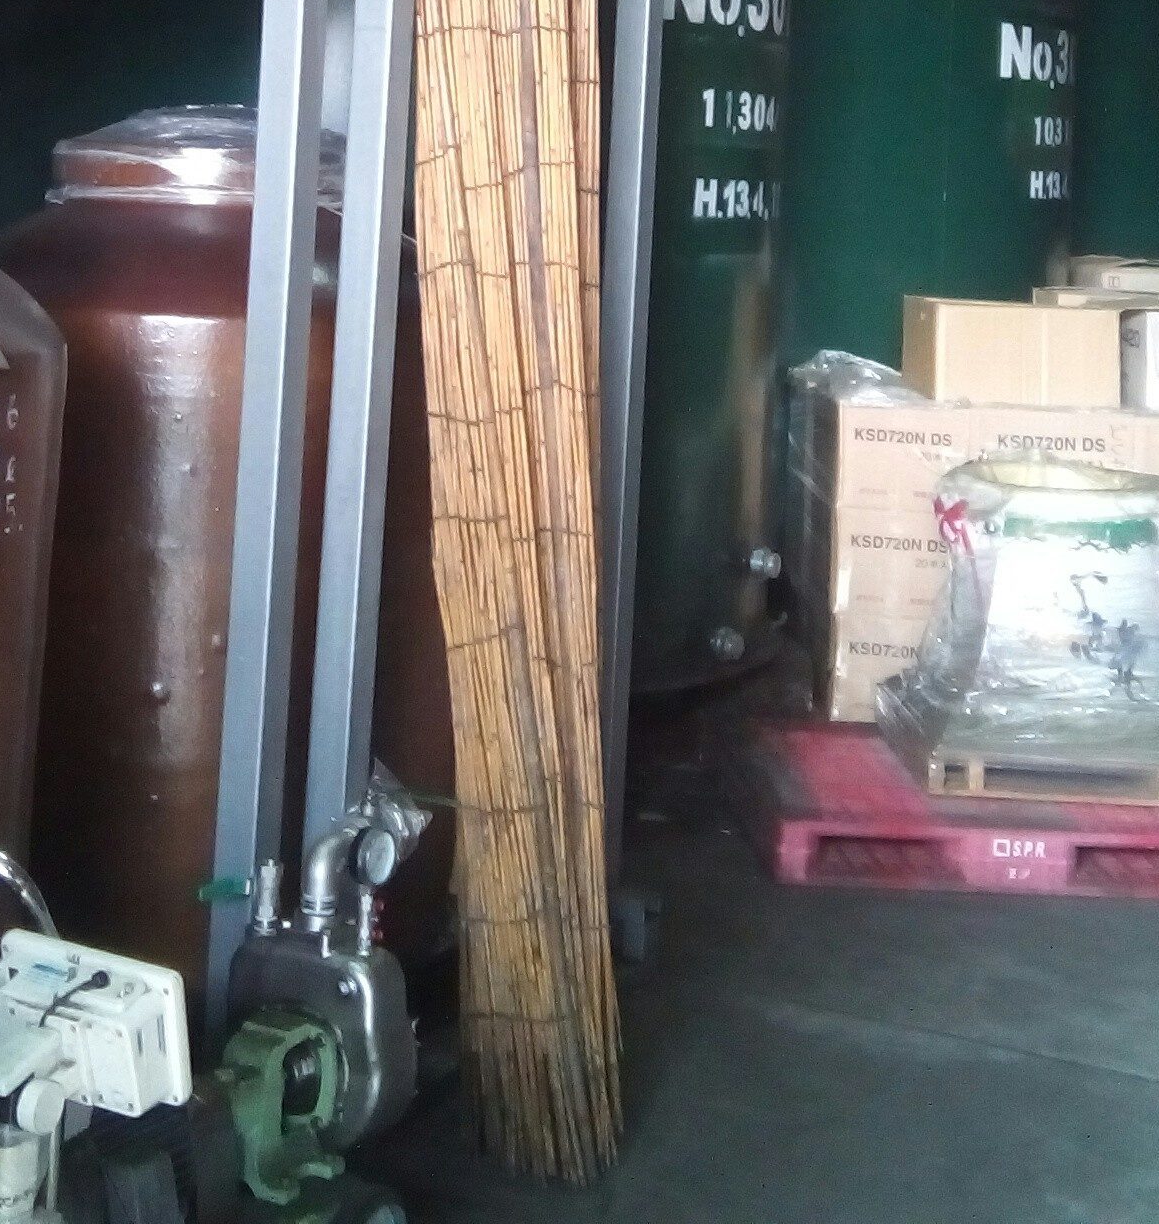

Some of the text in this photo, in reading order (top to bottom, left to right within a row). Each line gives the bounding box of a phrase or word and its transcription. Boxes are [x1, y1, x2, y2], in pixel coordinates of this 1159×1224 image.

[853, 427, 953, 447] KSD720N DS
[997, 434, 1107, 453] KSD720N DS
[850, 535, 922, 551] KSD720N
